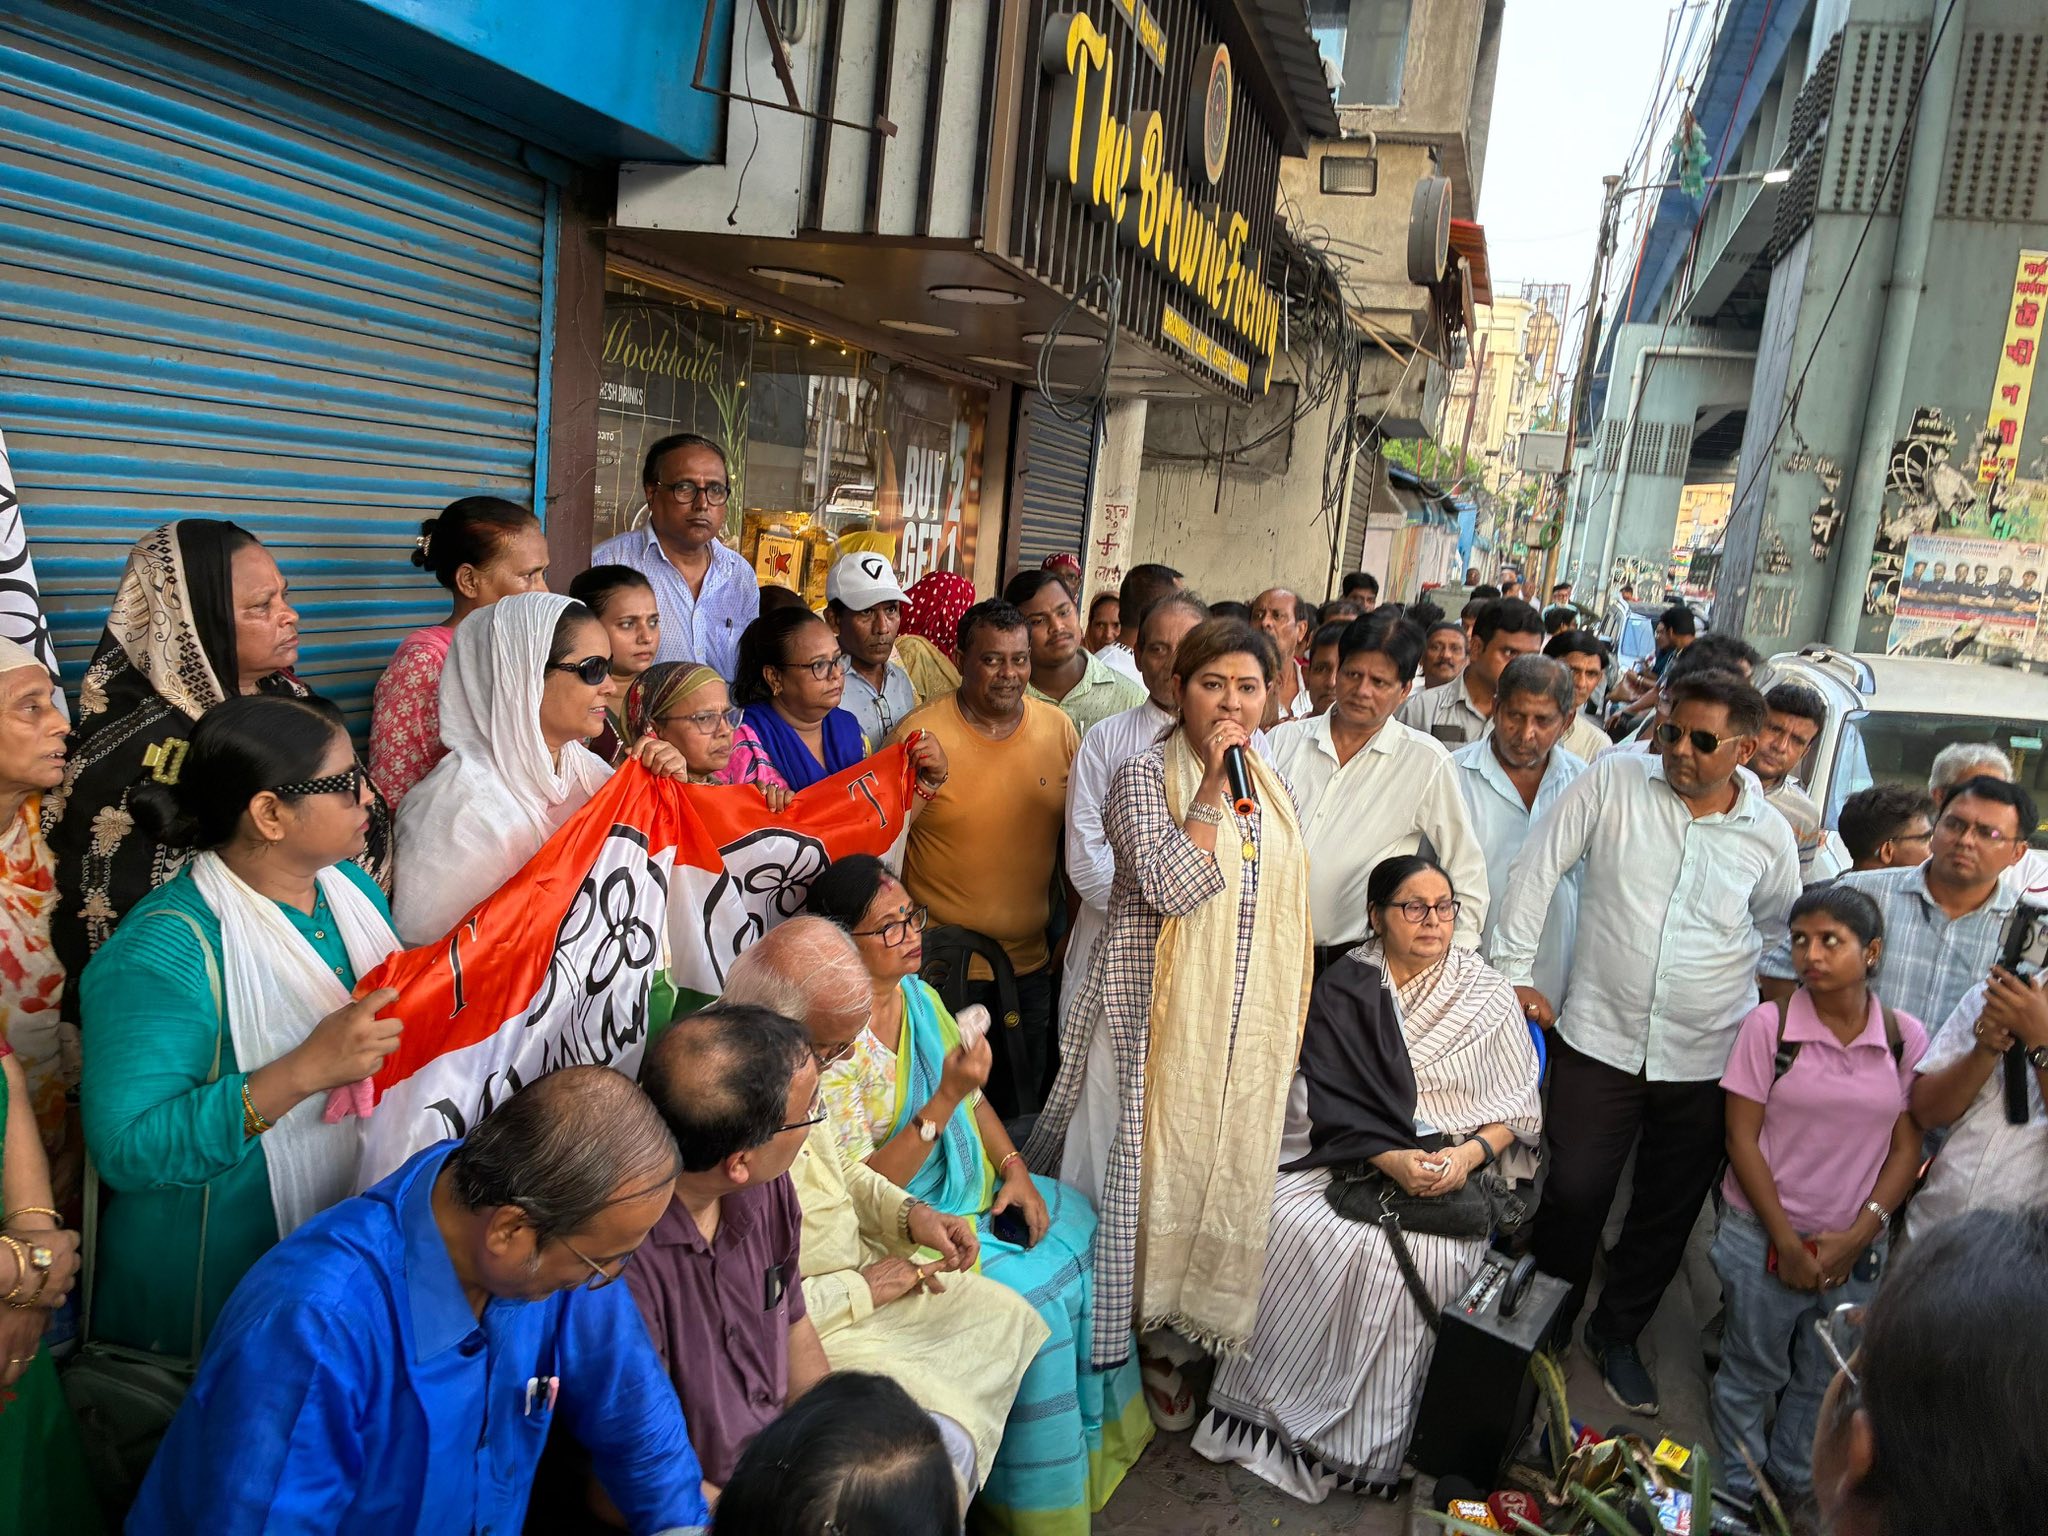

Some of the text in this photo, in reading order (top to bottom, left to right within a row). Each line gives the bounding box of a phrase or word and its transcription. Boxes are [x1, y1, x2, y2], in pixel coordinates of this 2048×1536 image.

[1066, 11, 1280, 395] The Brownie Factory
[1196, 332, 1210, 361] CAKE
[618, 384, 644, 406] DRINKS
[902, 445, 965, 522] BUY 2
[900, 521, 957, 592] GET 1
